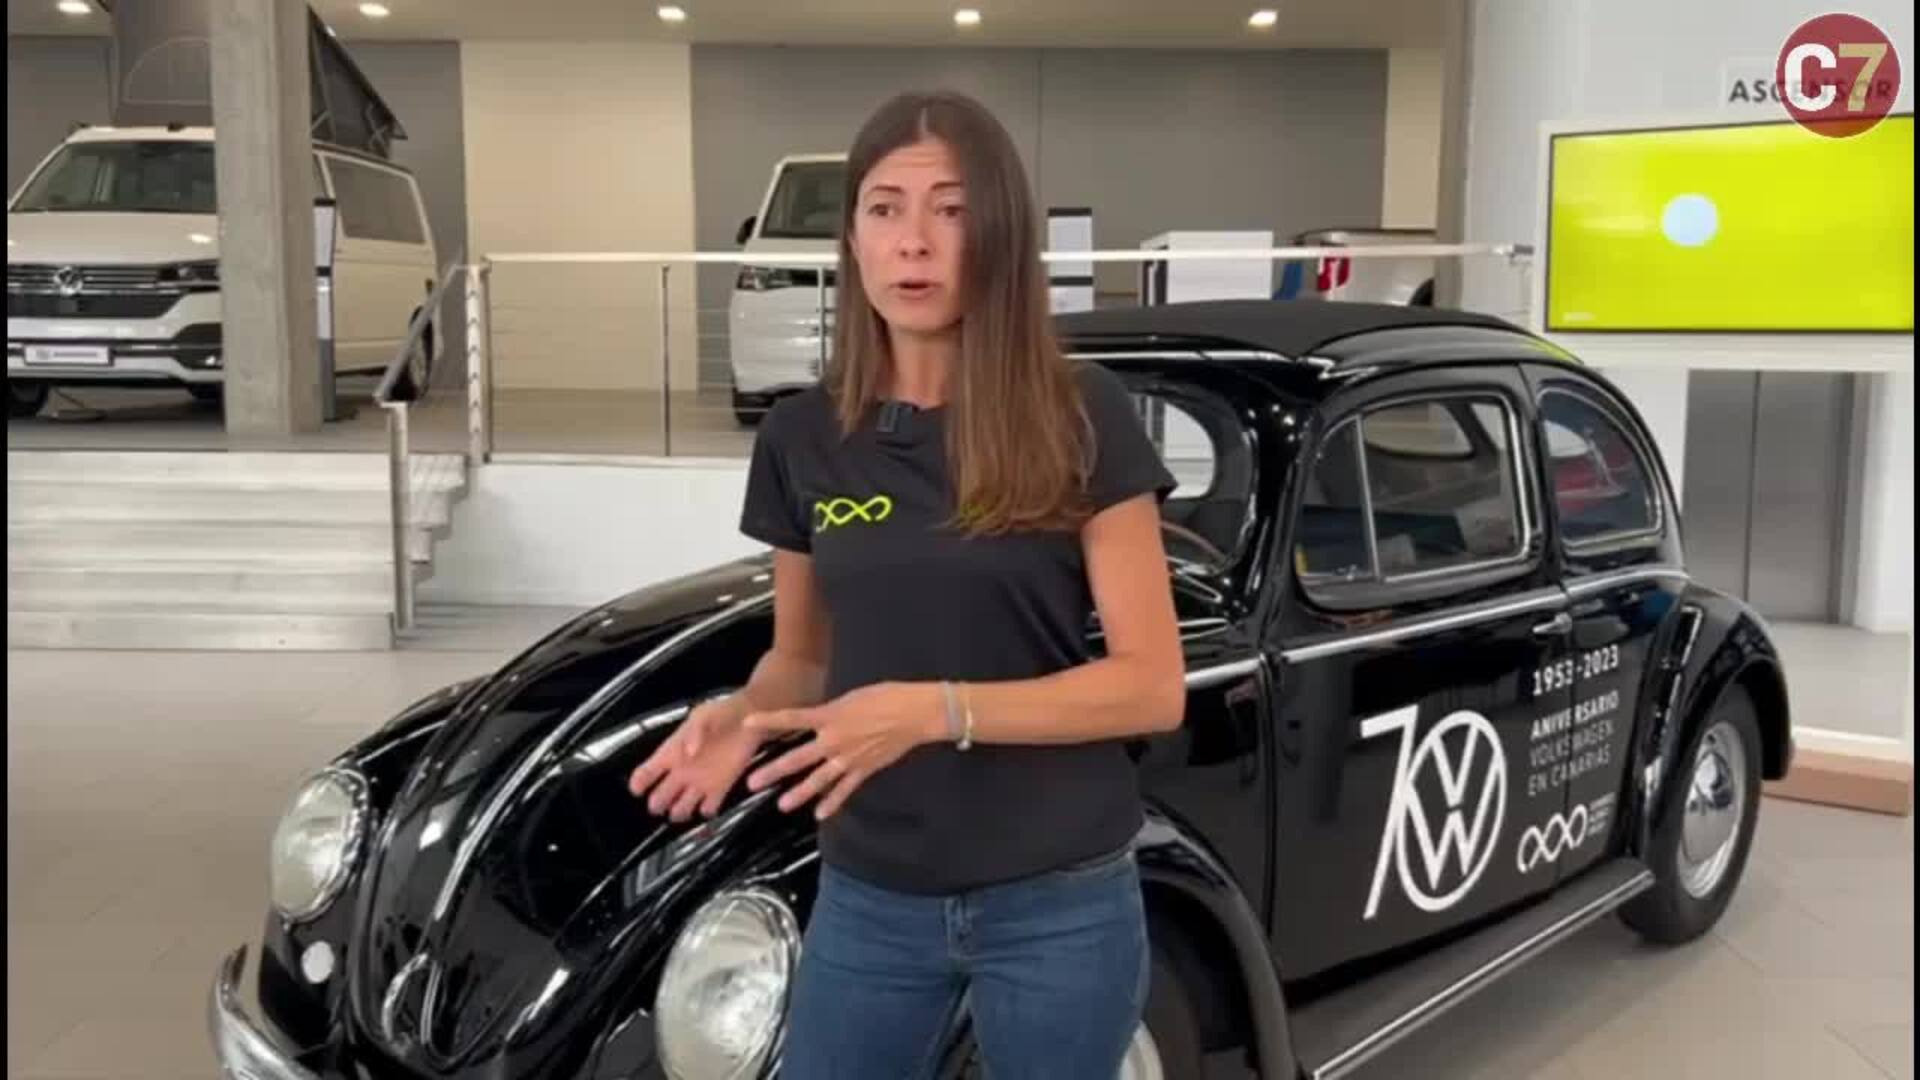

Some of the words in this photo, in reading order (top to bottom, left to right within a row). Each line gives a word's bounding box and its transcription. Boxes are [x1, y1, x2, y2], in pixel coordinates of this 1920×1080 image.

[1532, 644, 1619, 696] 1953-2023
[1530, 690, 1620, 741] ANIVERSARIO
[1527, 773, 1548, 797] EN
